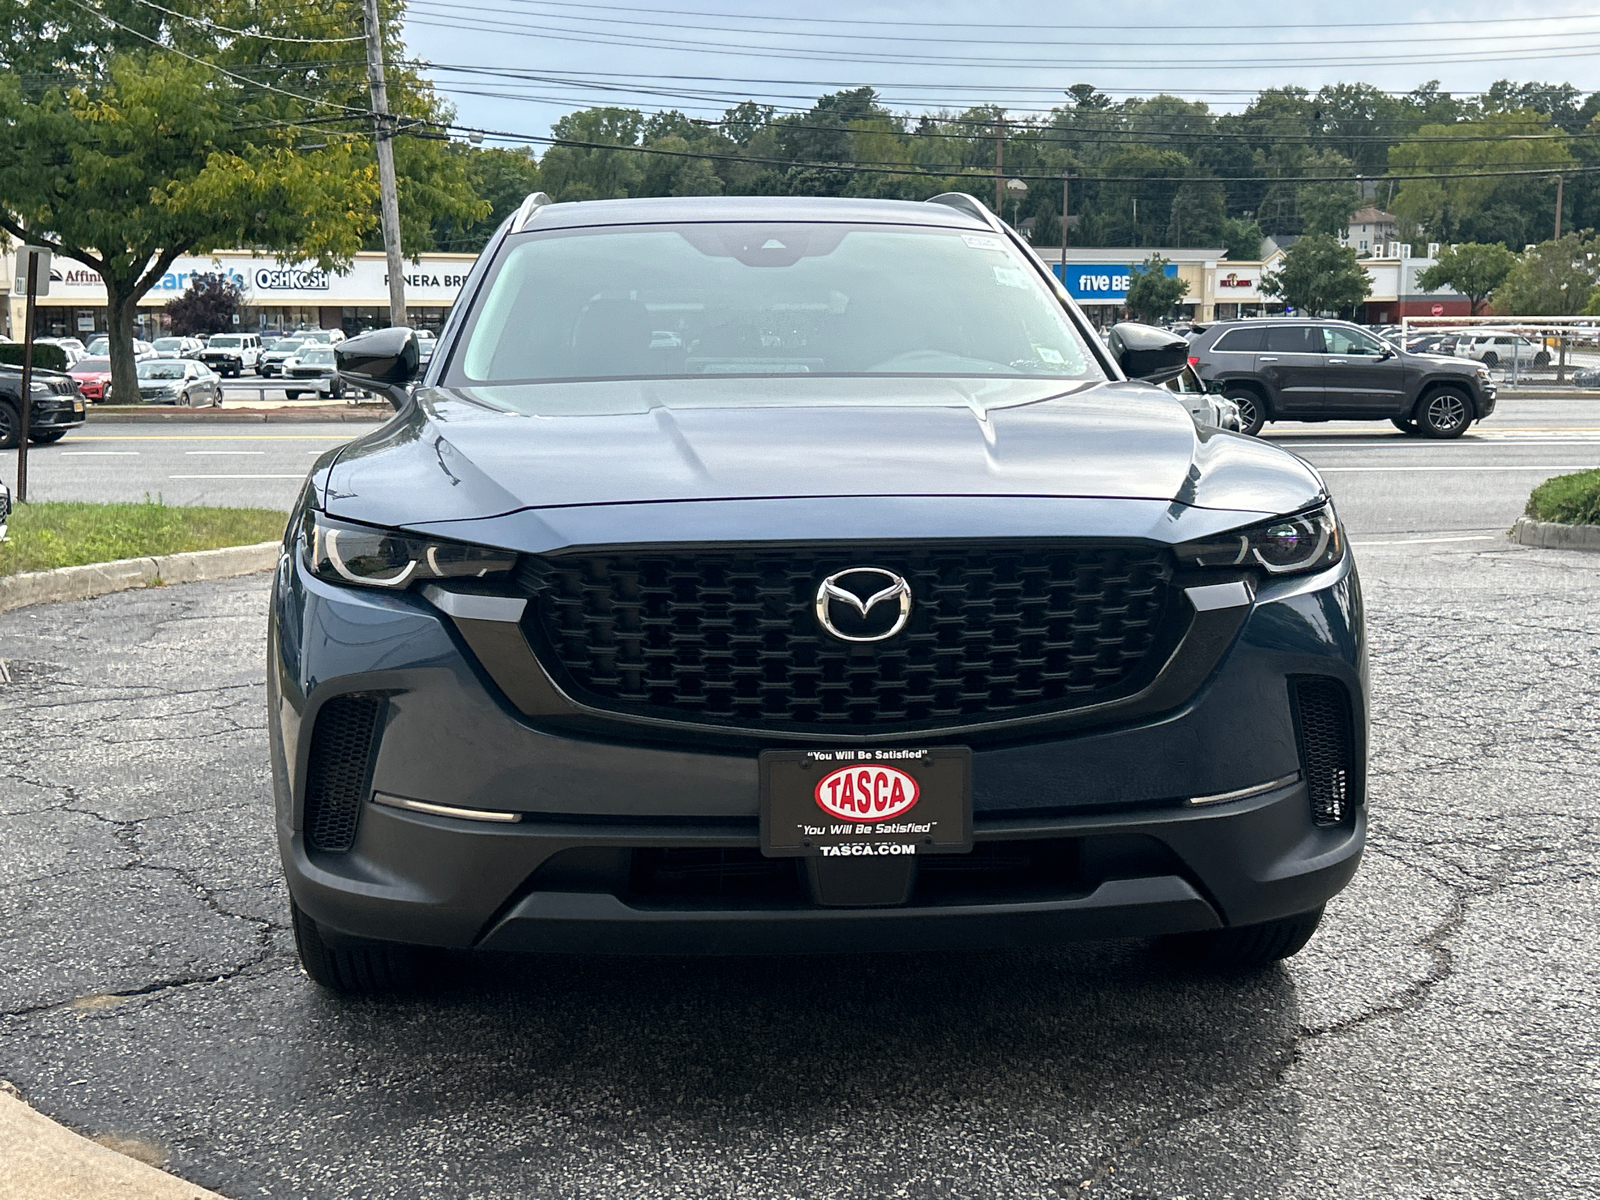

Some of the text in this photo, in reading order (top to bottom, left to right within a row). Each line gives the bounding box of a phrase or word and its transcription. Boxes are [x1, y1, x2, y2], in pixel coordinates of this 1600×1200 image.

[66, 270, 101, 282] Affini
[384, 274, 441, 287] PNERA
[1111, 275, 1131, 291] BE
[807, 752, 832, 760] “You
[835, 751, 855, 760] Will
[858, 751, 872, 759] Be
[827, 770, 906, 814] TASCA
[830, 824, 852, 834] Will
[855, 823, 872, 834] Be
[820, 844, 916, 857] TASCA.COM
